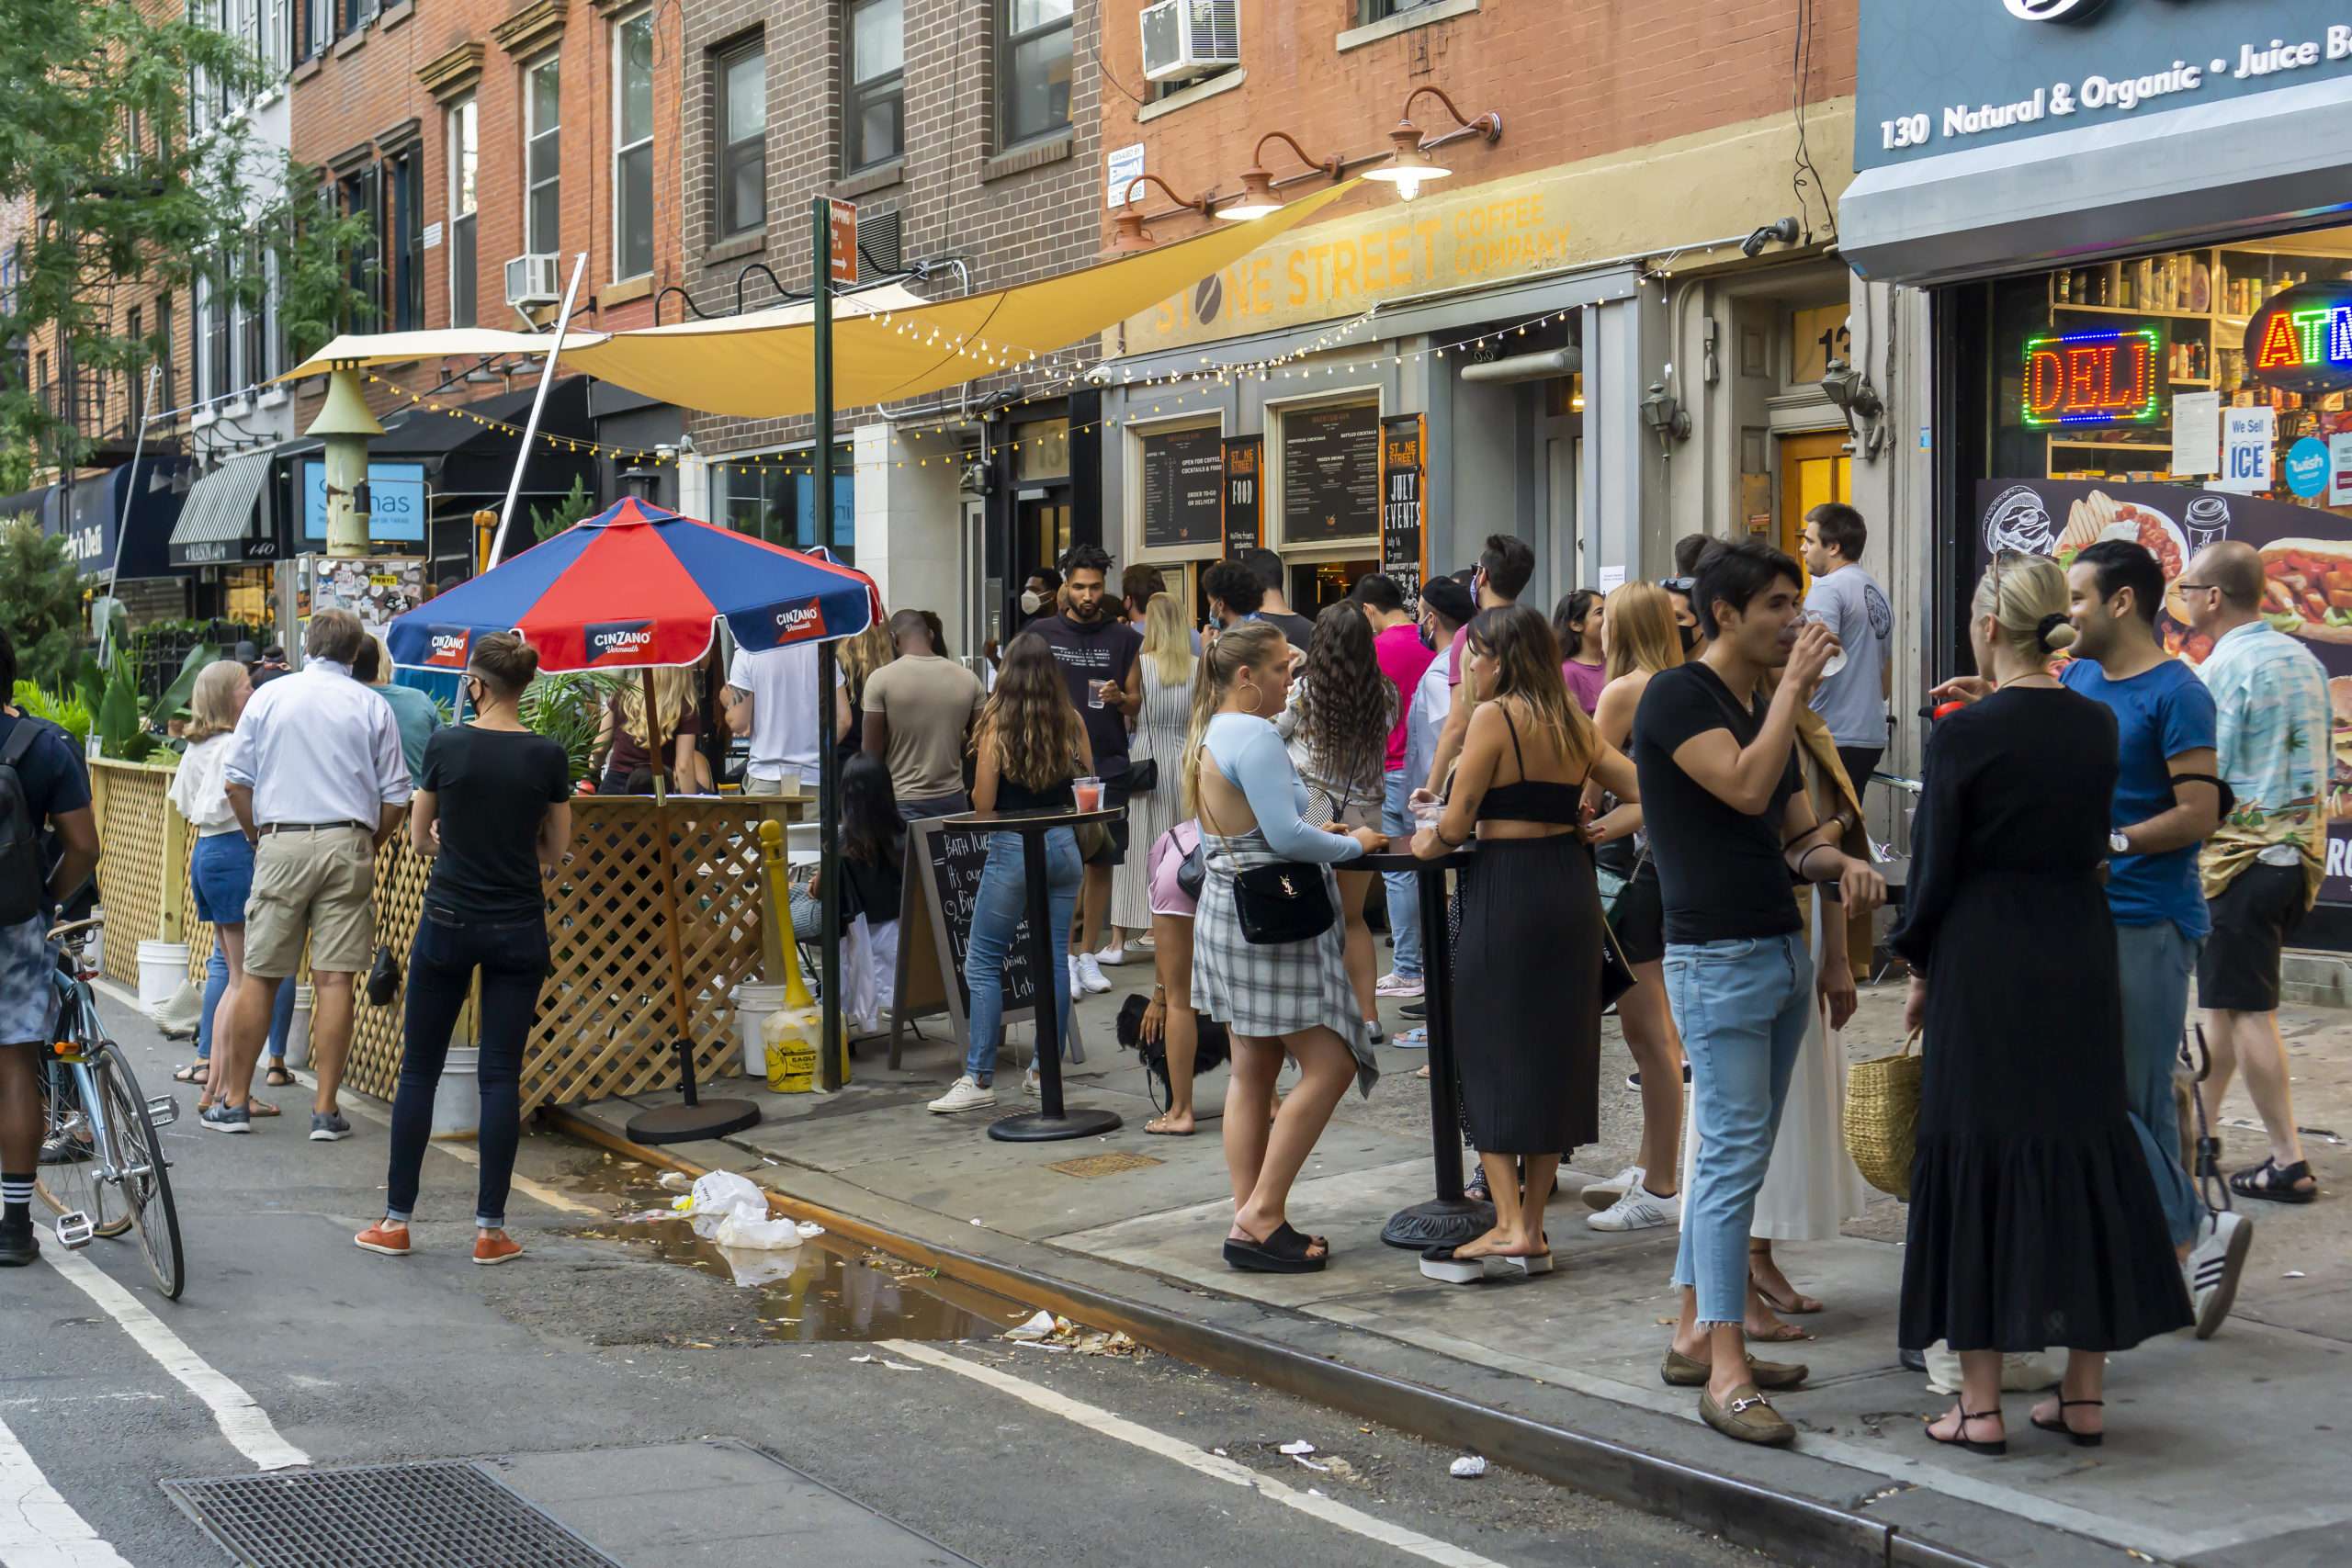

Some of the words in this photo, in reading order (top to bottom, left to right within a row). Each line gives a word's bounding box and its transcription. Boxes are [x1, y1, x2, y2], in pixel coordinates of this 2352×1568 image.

[1881, 113, 1930, 150] 130
[1942, 88, 2045, 138] Natural
[2049, 83, 2076, 116] &
[2080, 60, 2201, 109] Organic
[2233, 39, 2319, 79] Juice
[1454, 193, 1544, 241] COFFEE
[1454, 220, 1572, 276] COMPANY
[1288, 219, 1442, 307] STREET
[2030, 344, 2149, 411] DELI
[2232, 420, 2245, 433] We
[2247, 419, 2264, 433] Sell
[1389, 452, 1417, 464] STREET
[2231, 441, 2264, 478] ICE
[1232, 479, 1253, 505] FOOD
[1390, 473, 1415, 502] JULY
[1194, 498, 1216, 506] DELIVERY
[1385, 501, 1420, 530] EVENTS
[249, 543, 276, 556] 140
[1386, 536, 1395, 549] July
[775, 607, 818, 626] CINZANO
[431, 635, 464, 650] CINZANO
[594, 630, 650, 646] CINZANO
[605, 645, 639, 654] Vermouth
[944, 834, 969, 859] BATH
[947, 865, 962, 889] It's
[966, 867, 982, 883] our
